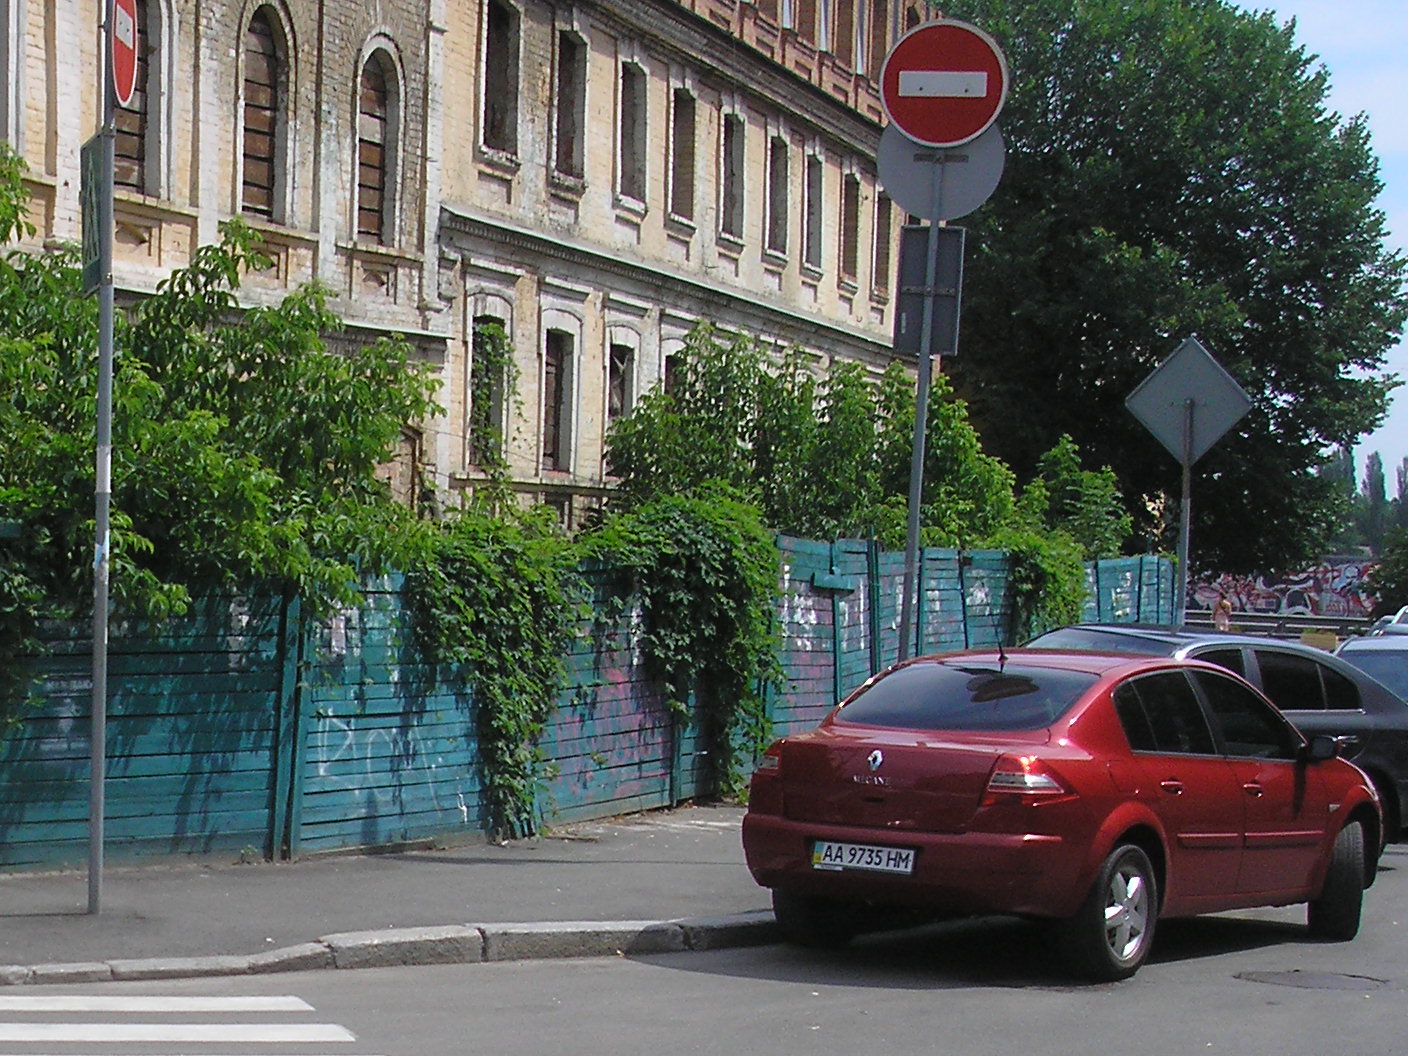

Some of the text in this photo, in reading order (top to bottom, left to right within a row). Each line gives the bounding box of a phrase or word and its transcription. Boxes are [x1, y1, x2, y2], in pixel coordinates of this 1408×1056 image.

[822, 844, 911, 869] AA 9735 HM
